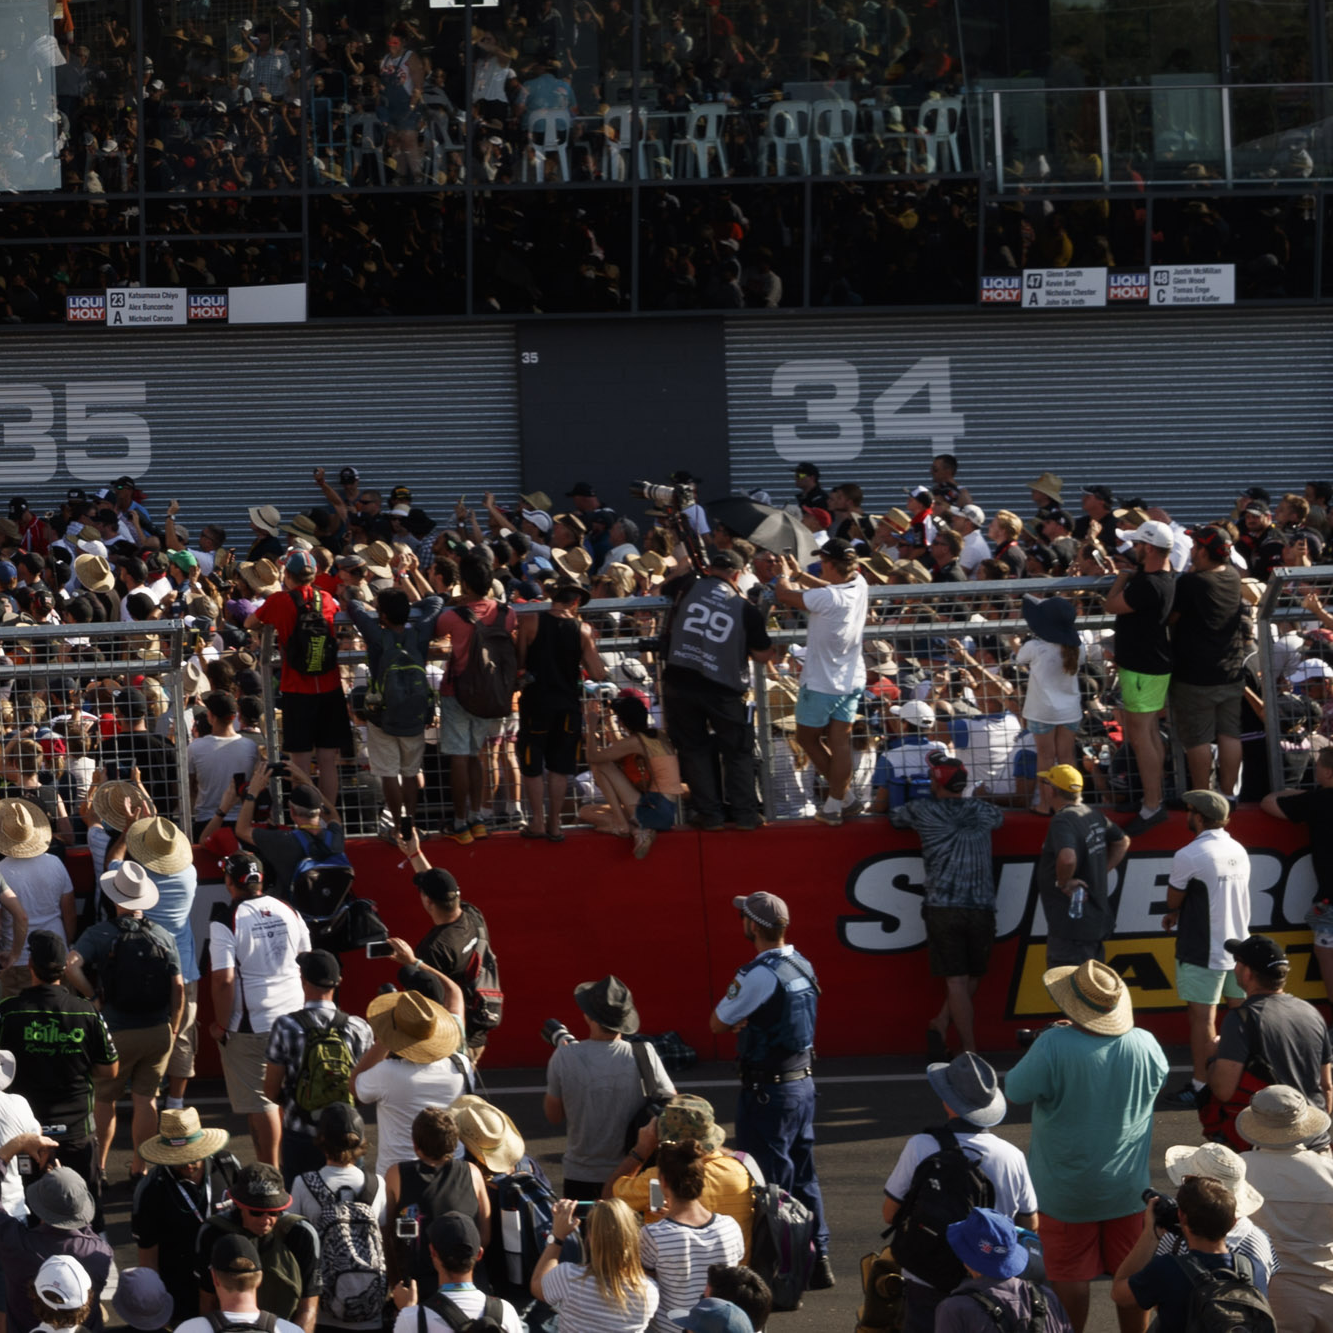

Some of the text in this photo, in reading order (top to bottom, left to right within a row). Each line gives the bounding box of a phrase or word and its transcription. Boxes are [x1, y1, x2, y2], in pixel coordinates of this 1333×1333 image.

[983, 278, 1019, 290] LIQUI
[1028, 274, 1042, 288] 47
[1110, 274, 1146, 287] LIQUI
[1154, 271, 1169, 285] 48
[161, 291, 179, 301] Chiyo
[982, 289, 1021, 302] MOLY
[1029, 292, 1038, 306] A
[1109, 286, 1148, 299] MOLY
[1157, 288, 1166, 303] C
[69, 296, 104, 308] LIQUI
[110, 293, 125, 307] 23
[190, 295, 225, 307] LIQUI
[69, 307, 105, 320] MOLY
[128, 303, 141, 311] Alex
[189, 306, 227, 318] MOLY
[113, 310, 123, 325] A
[128, 314, 151, 322] Michael
[521, 352, 539, 364] 35
[770, 356, 965, 462] 34
[682, 602, 735, 643] 29
